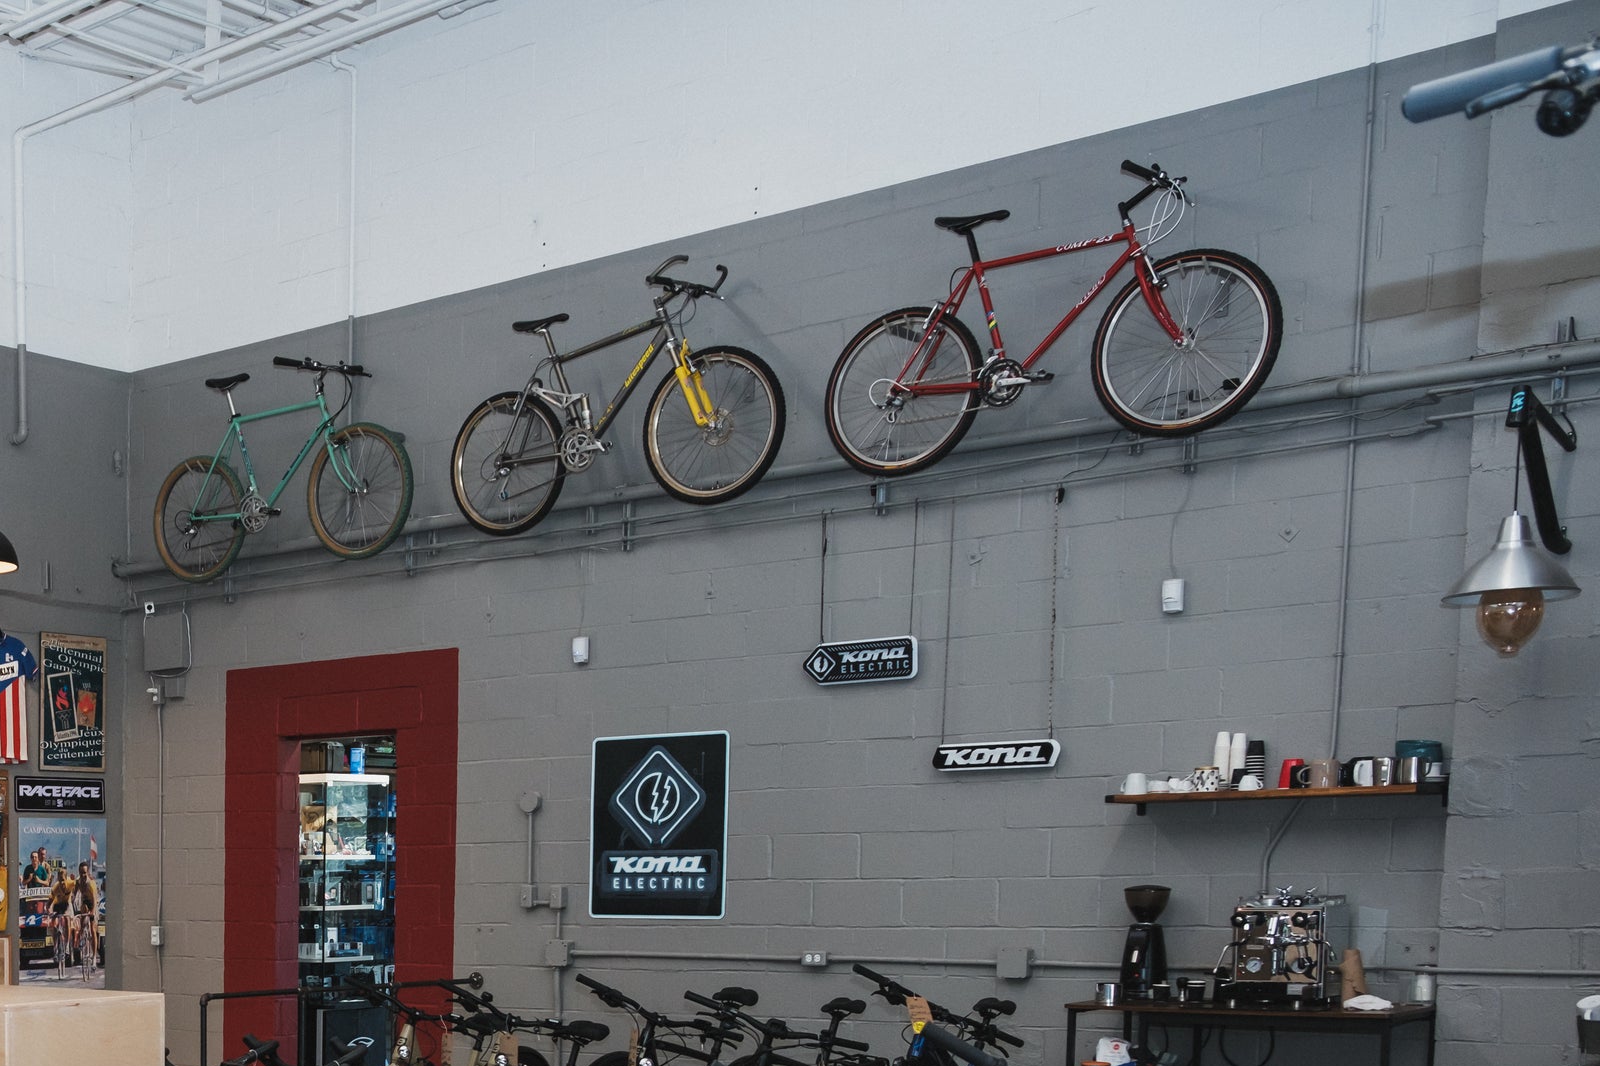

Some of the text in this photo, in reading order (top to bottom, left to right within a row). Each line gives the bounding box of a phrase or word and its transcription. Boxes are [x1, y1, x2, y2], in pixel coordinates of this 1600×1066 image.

[58, 653, 106, 673] Olympic
[840, 658, 910, 675] ELECTRIC
[18, 784, 100, 798] RACEFACE
[23, 826, 69, 834] CAMPAGNOLO
[612, 876, 706, 890] ELECTRIC
